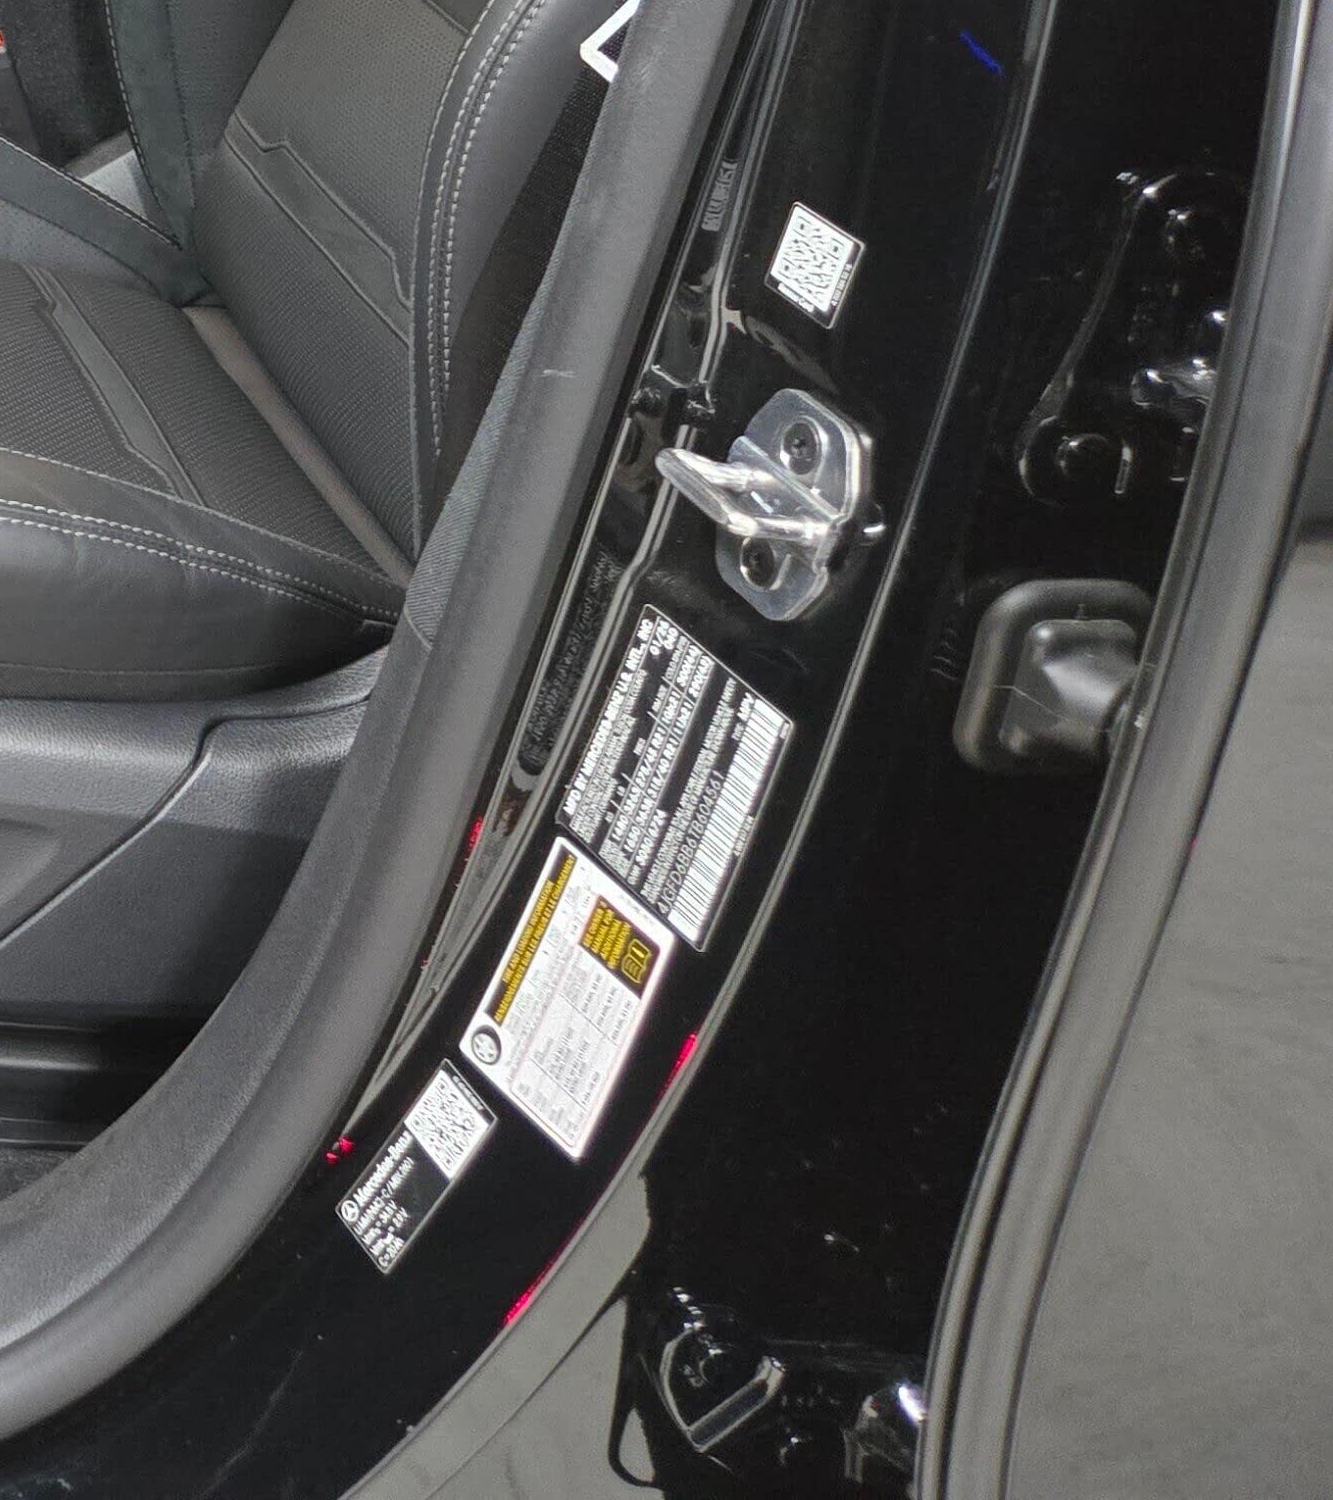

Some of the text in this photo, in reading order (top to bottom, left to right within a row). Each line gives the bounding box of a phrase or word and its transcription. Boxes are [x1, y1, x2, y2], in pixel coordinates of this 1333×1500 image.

[563, 789, 581, 815] MFD
[574, 773, 587, 791] BY
[581, 690, 623, 775] MERCEDES-BENZ
[737, 692, 754, 721] MPV
[658, 770, 722, 913] 4JGFD6BB6TB604561
[353, 1131, 412, 1206] Mercedes-Benz
